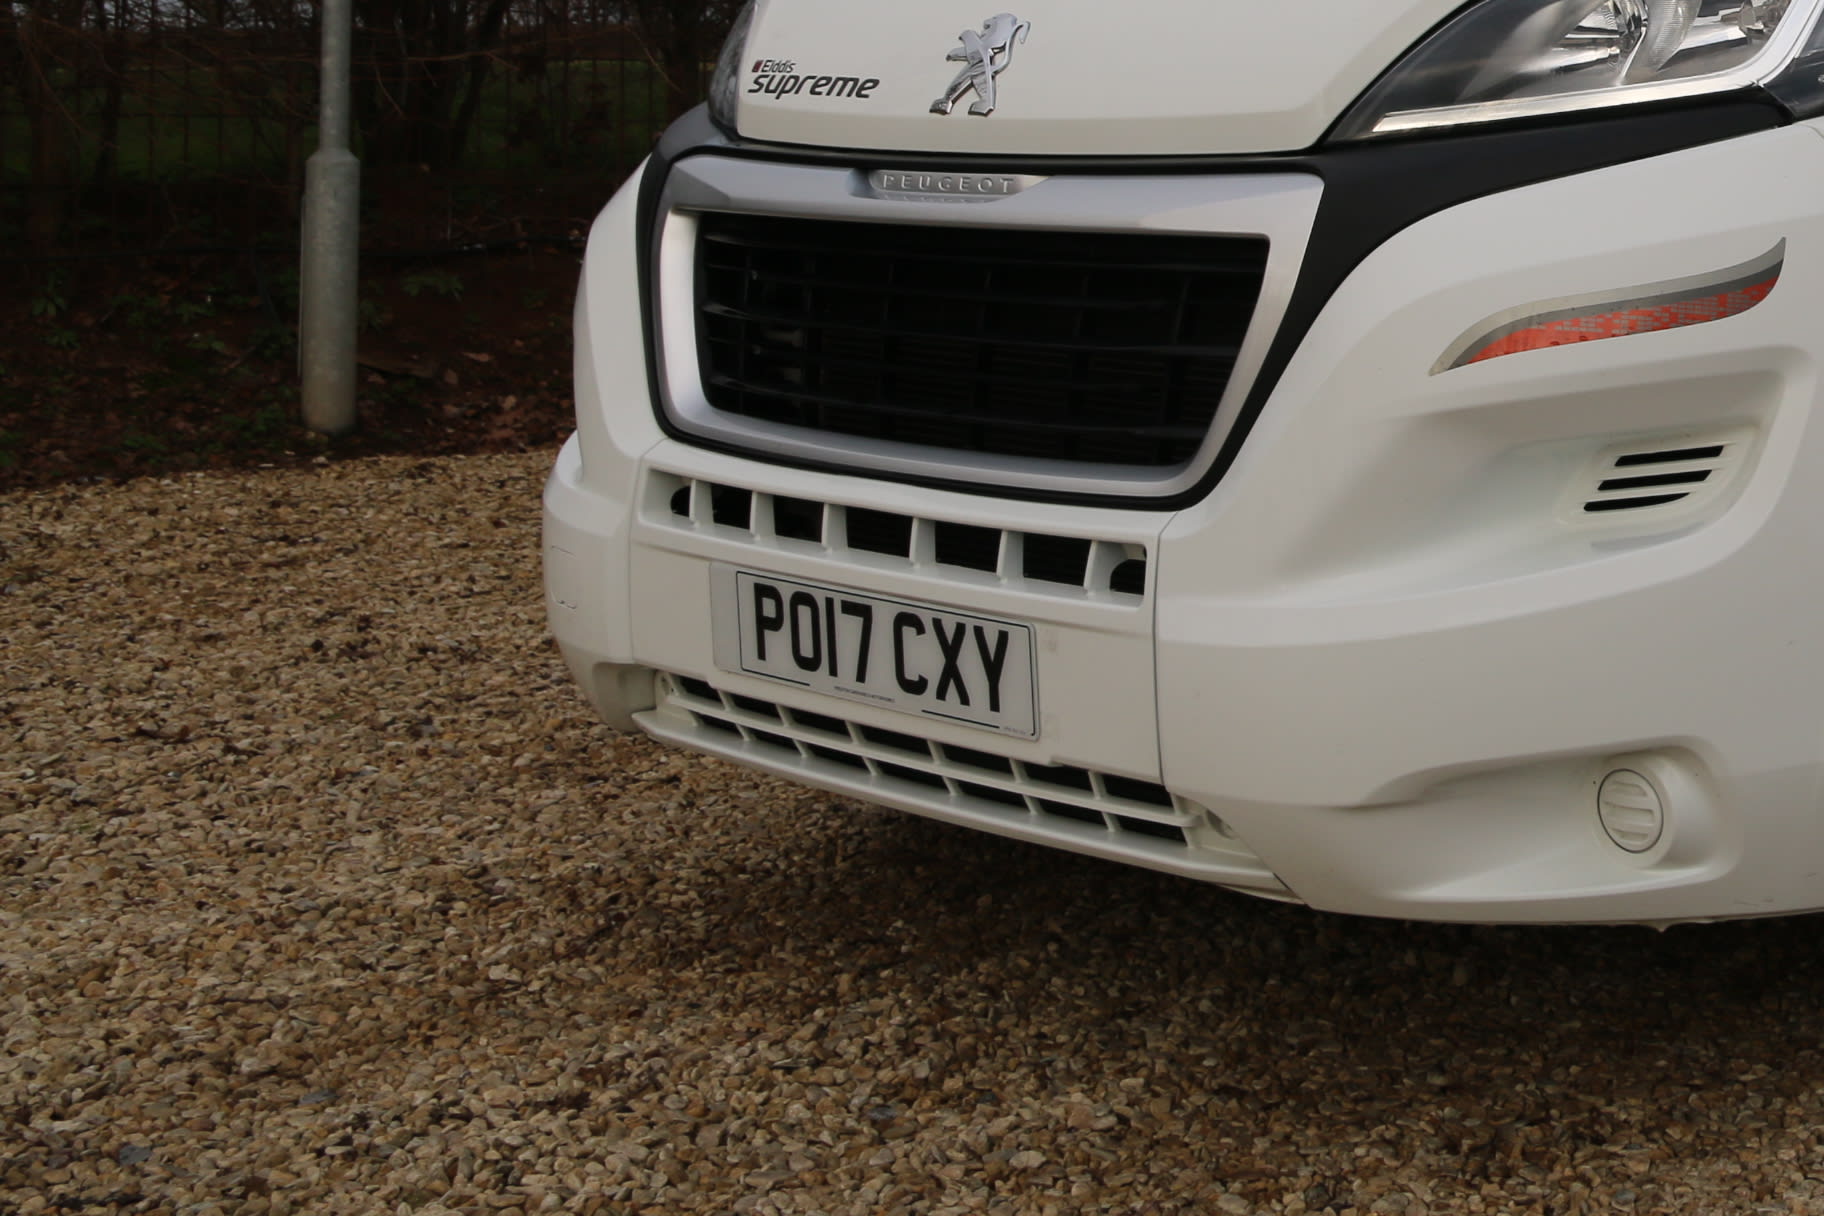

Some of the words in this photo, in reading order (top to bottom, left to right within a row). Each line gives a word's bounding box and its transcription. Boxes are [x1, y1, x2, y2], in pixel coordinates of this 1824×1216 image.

[761, 59, 798, 74] Elddis
[747, 74, 881, 101] supreme
[882, 174, 1014, 193] PEUGEOT
[753, 582, 873, 684] PO17
[892, 611, 1010, 714] CXY
